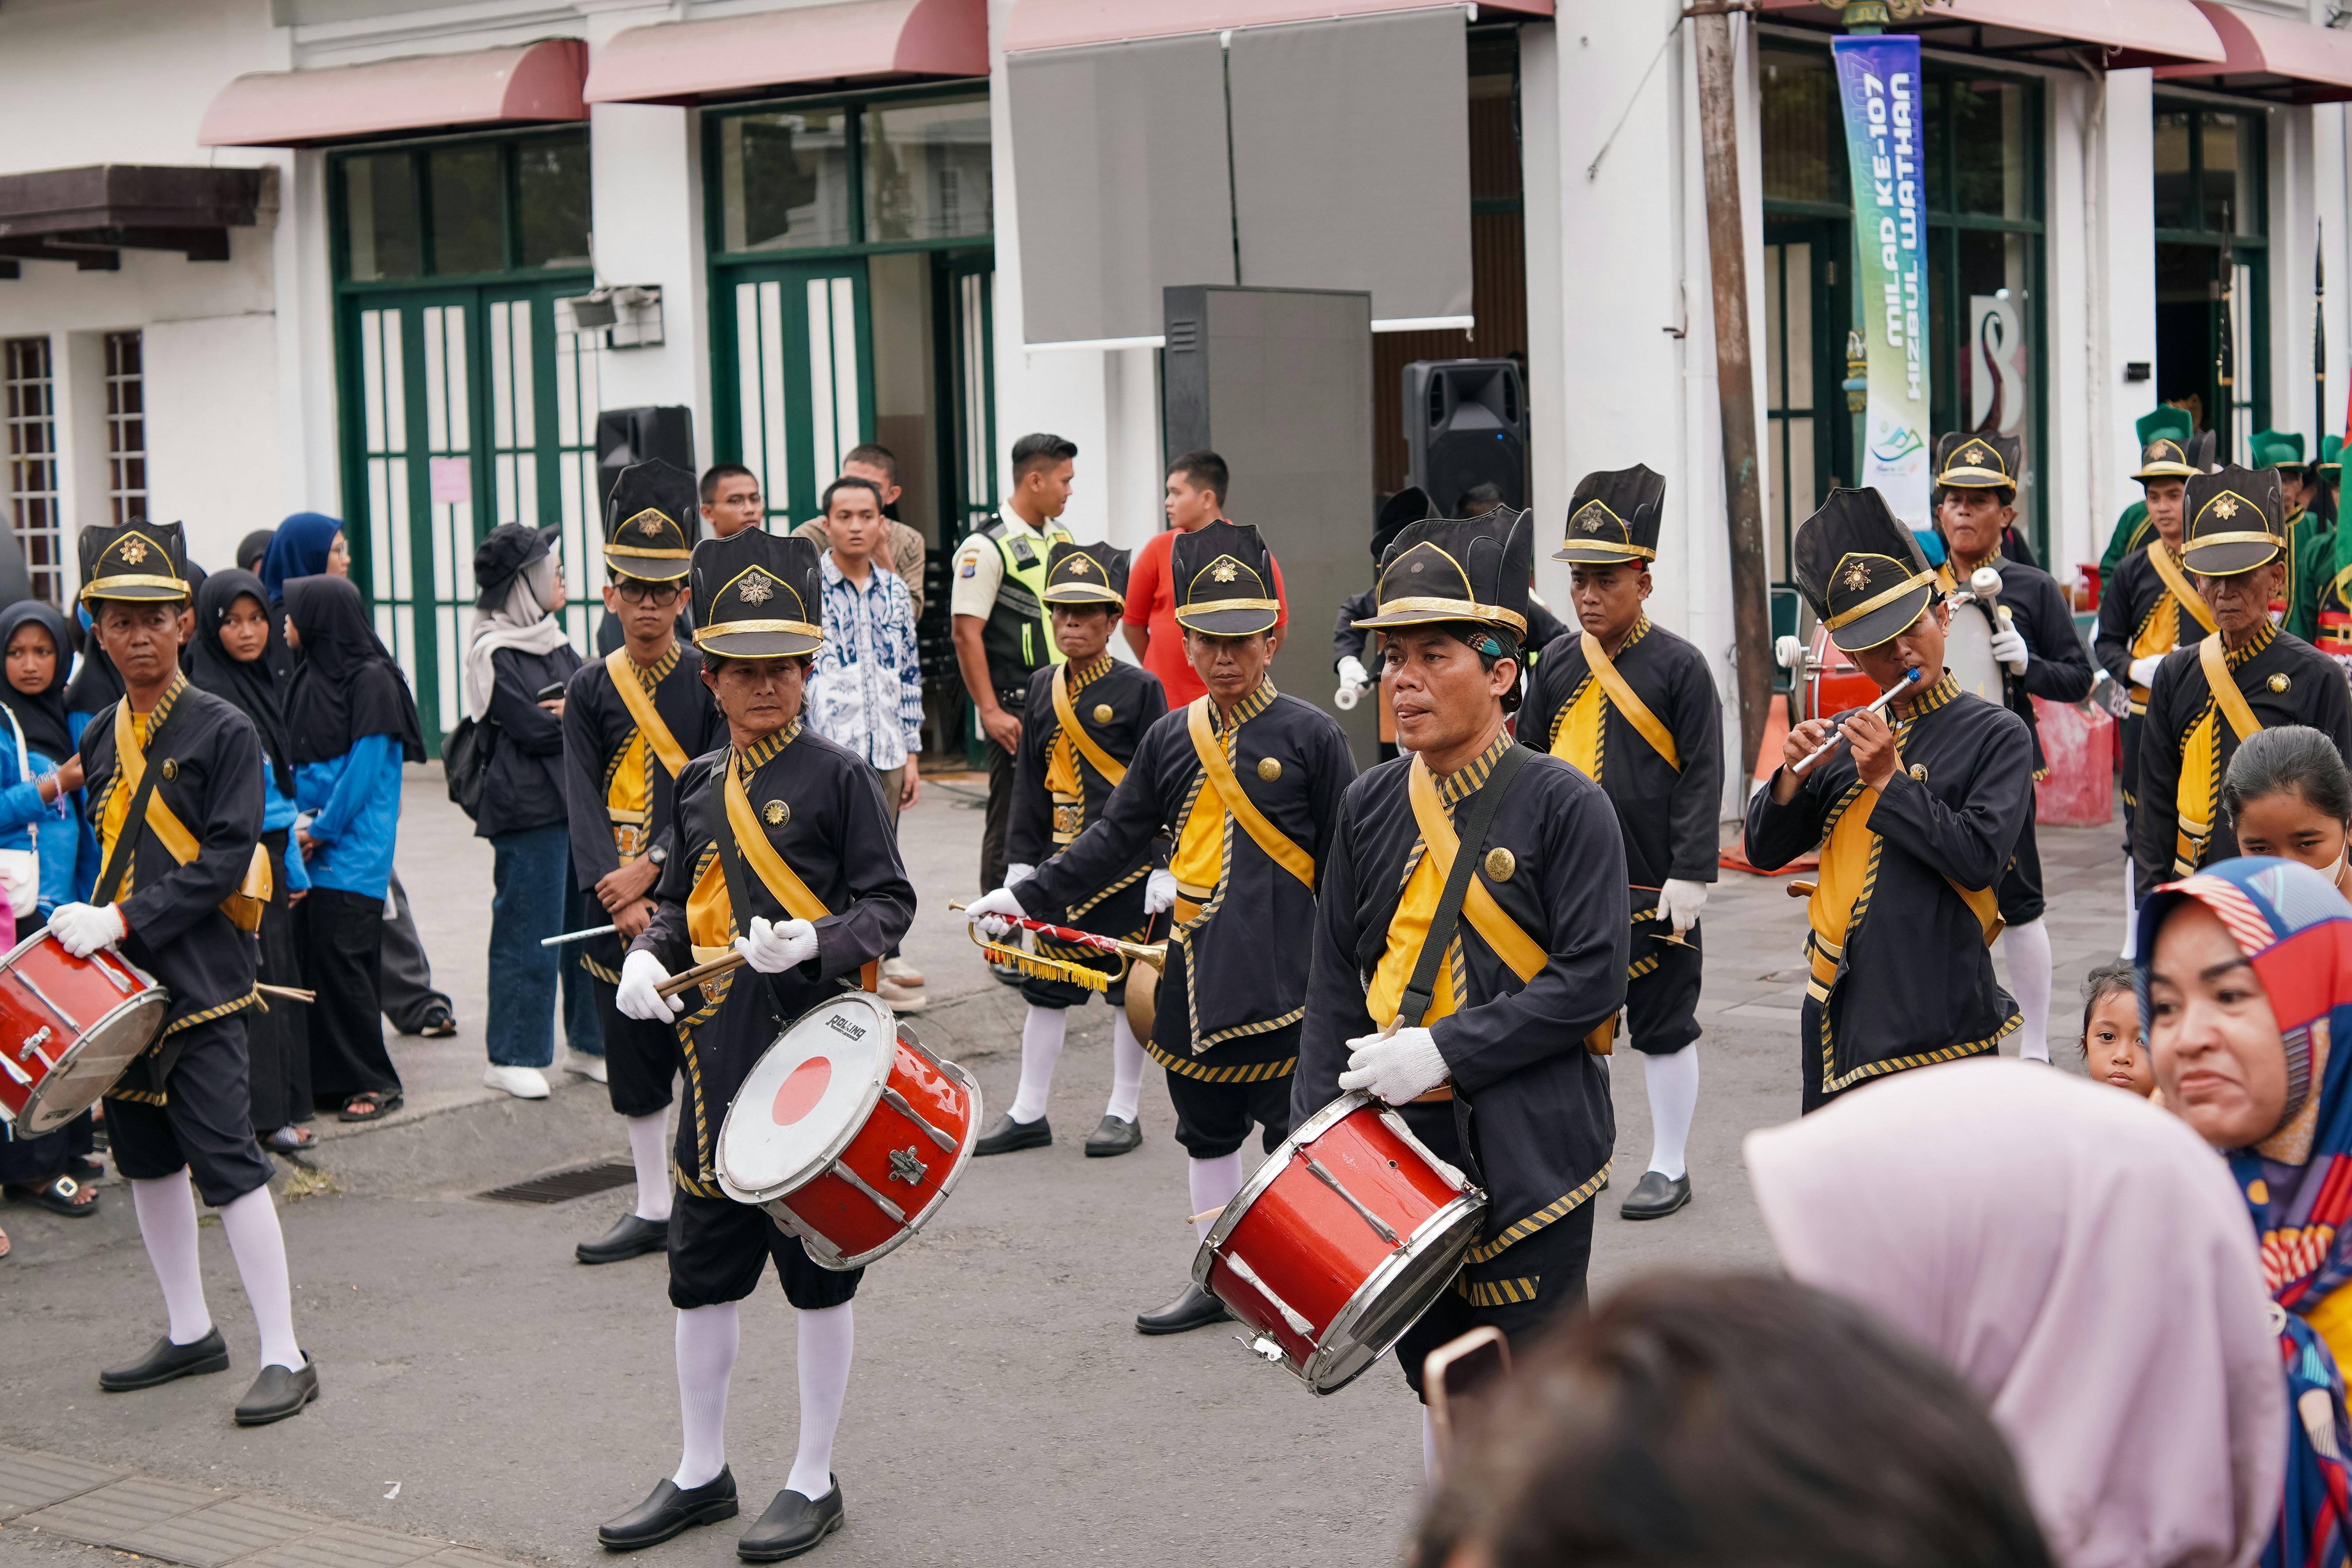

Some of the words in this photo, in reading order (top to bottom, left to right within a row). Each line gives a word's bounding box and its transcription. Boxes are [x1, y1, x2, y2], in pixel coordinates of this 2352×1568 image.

[1863, 73, 1894, 207] KE-107
[1889, 73, 1917, 249] WATHAN
[1880, 216, 1903, 347] MILAD
[1904, 260, 1921, 400] HIZBUL
[825, 1014, 867, 1041] ROLLING
